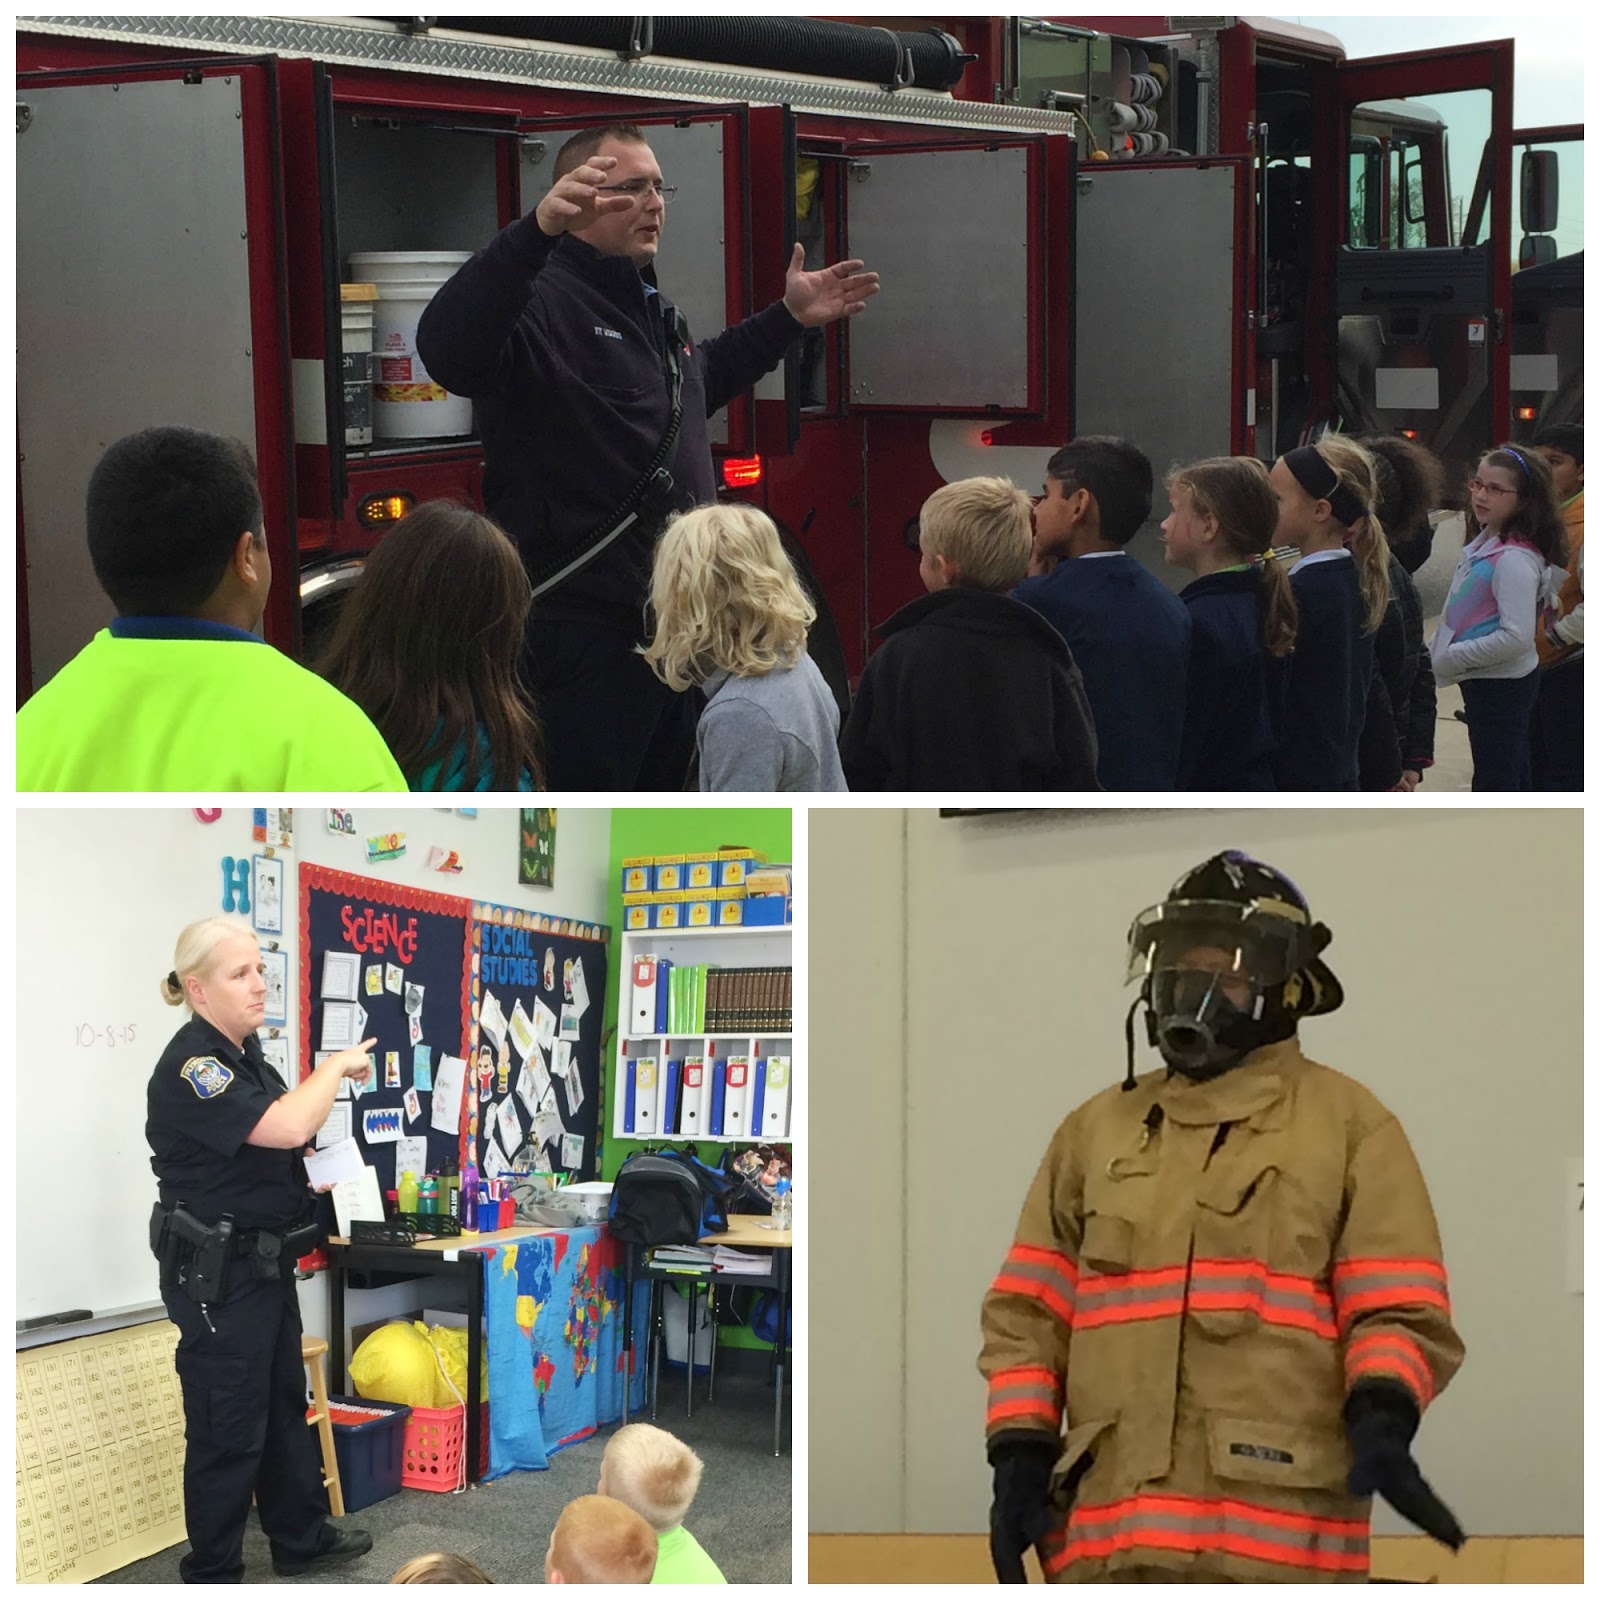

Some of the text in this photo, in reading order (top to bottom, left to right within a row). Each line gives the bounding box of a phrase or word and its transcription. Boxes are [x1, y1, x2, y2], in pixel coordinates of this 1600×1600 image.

[221, 856, 251, 914] H
[341, 905, 417, 964] SCIENCE
[481, 923, 534, 957] SOCIAL
[481, 959, 539, 987] STUDIES
[76, 1023, 137, 1048] 10-8-15
[206, 1074, 228, 1094] POLICE
[26, 1367, 37, 1376] 151
[46, 1363, 57, 1372] 161
[66, 1359, 76, 1368] 171
[84, 1354, 94, 1363] 181
[135, 1343, 145, 1351] 211
[31, 1387, 43, 1397] 152
[51, 1382, 63, 1392] 162
[70, 1378, 82, 1387] 172
[88, 1373, 99, 1382] 182
[106, 1368, 117, 1378] 192
[123, 1364, 134, 1373] 202
[140, 1360, 150, 1370] 212
[36, 1407, 48, 1416] 153
[56, 1402, 68, 1411] 163
[75, 1397, 86, 1406] 173
[110, 1387, 121, 1396] 193
[127, 1383, 139, 1392] 203
[143, 1378, 154, 1388] 213
[160, 1374, 170, 1384] 223
[21, 1432, 33, 1441] 144
[41, 1427, 53, 1436] 154
[60, 1421, 72, 1430] 164
[114, 1406, 125, 1415] 194
[131, 1401, 142, 1411] 204
[163, 1392, 174, 1402] 224
[26, 1451, 39, 1461] 145
[46, 1446, 58, 1455] 155
[65, 1440, 77, 1450] 165
[84, 1435, 96, 1444] 175
[102, 1429, 112, 1439] 185
[119, 1424, 130, 1433] 195
[30, 1472, 42, 1480] 146
[70, 1460, 81, 1469] 166
[89, 1454, 99, 1463] 176
[124, 1443, 135, 1452] 196
[35, 1491, 46, 1501] 147
[55, 1485, 66, 1495] 157
[74, 1478, 85, 1488] 167
[93, 1472, 103, 1482] 177
[110, 1466, 120, 1476] 187
[127, 1460, 137, 1470] 197
[143, 1455, 153, 1466] 207
[159, 1450, 168, 1460] 217
[20, 1518, 31, 1528] 138
[39, 1511, 51, 1521] 148
[60, 1505, 70, 1514] 158
[78, 1497, 89, 1508] 168
[97, 1491, 108, 1501] 178
[114, 1485, 124, 1495] 188
[131, 1479, 141, 1489] 198
[162, 1467, 172, 1478] 218
[23, 1538, 34, 1549] 139
[43, 1531, 55, 1541] 149
[62, 1524, 74, 1534] 159
[82, 1517, 92, 1527] 169
[100, 1510, 110, 1520] 179
[117, 1504, 127, 1514] 189
[135, 1497, 144, 1507] 199
[166, 1486, 175, 1496] 219
[26, 1503, 180, 1568] 140 150 160 170 180 190 200 210 220
